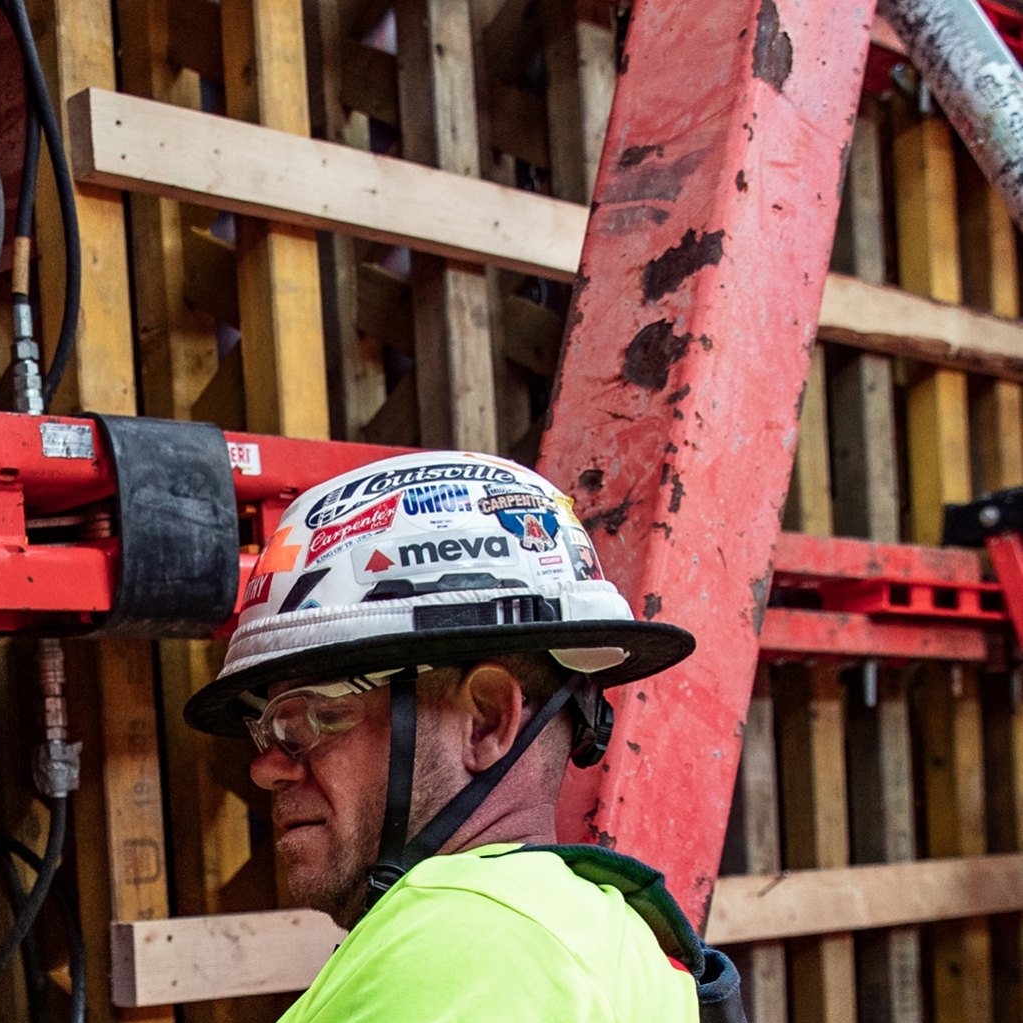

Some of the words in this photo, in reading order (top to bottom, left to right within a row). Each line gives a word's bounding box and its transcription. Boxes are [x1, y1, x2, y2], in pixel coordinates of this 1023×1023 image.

[230, 447, 250, 463] ERI
[313, 465, 514, 522] Louisville
[402, 484, 472, 516] UNION
[345, 533, 373, 547] TRDES
[398, 536, 510, 567] meva
